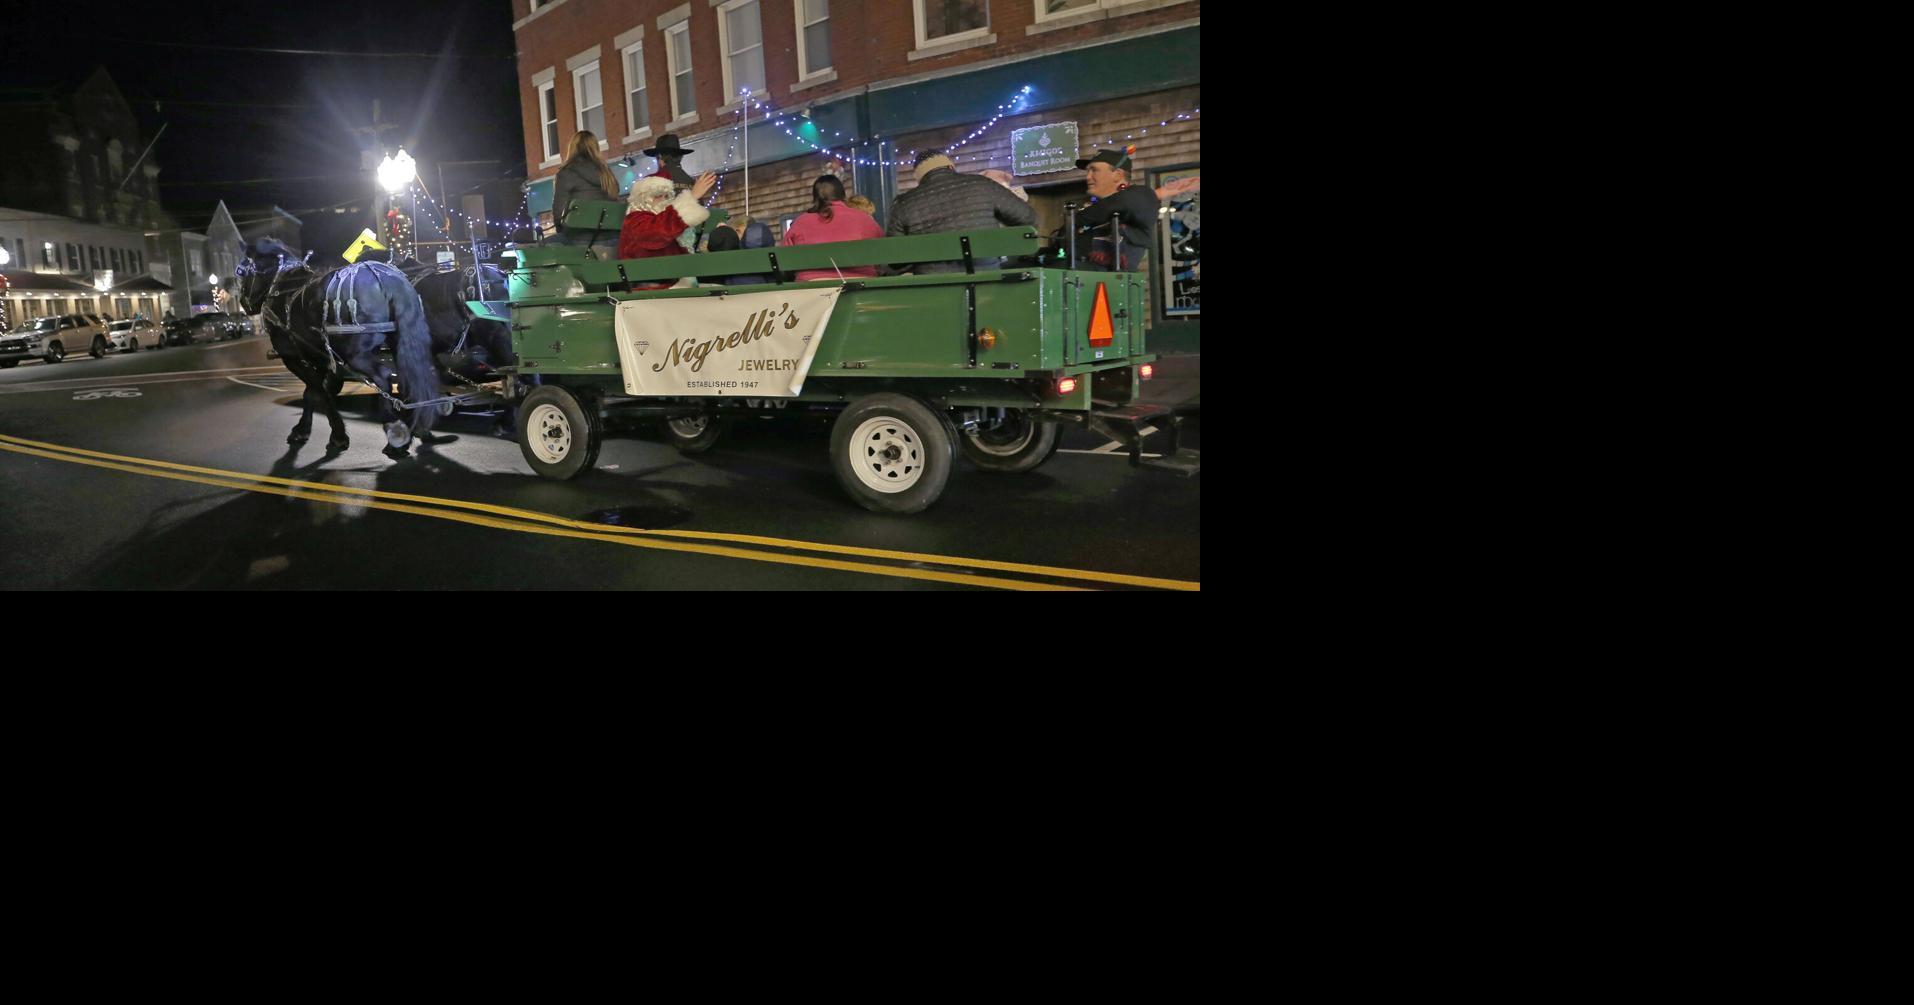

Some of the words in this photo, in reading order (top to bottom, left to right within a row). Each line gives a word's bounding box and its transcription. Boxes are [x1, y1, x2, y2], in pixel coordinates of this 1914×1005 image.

[1050, 157, 1071, 165] ROOM
[652, 302, 800, 373] Nigrelli's
[737, 359, 799, 371] JEWELRY
[687, 380, 738, 389] ESTABLISHED
[740, 381, 759, 389] 1947
